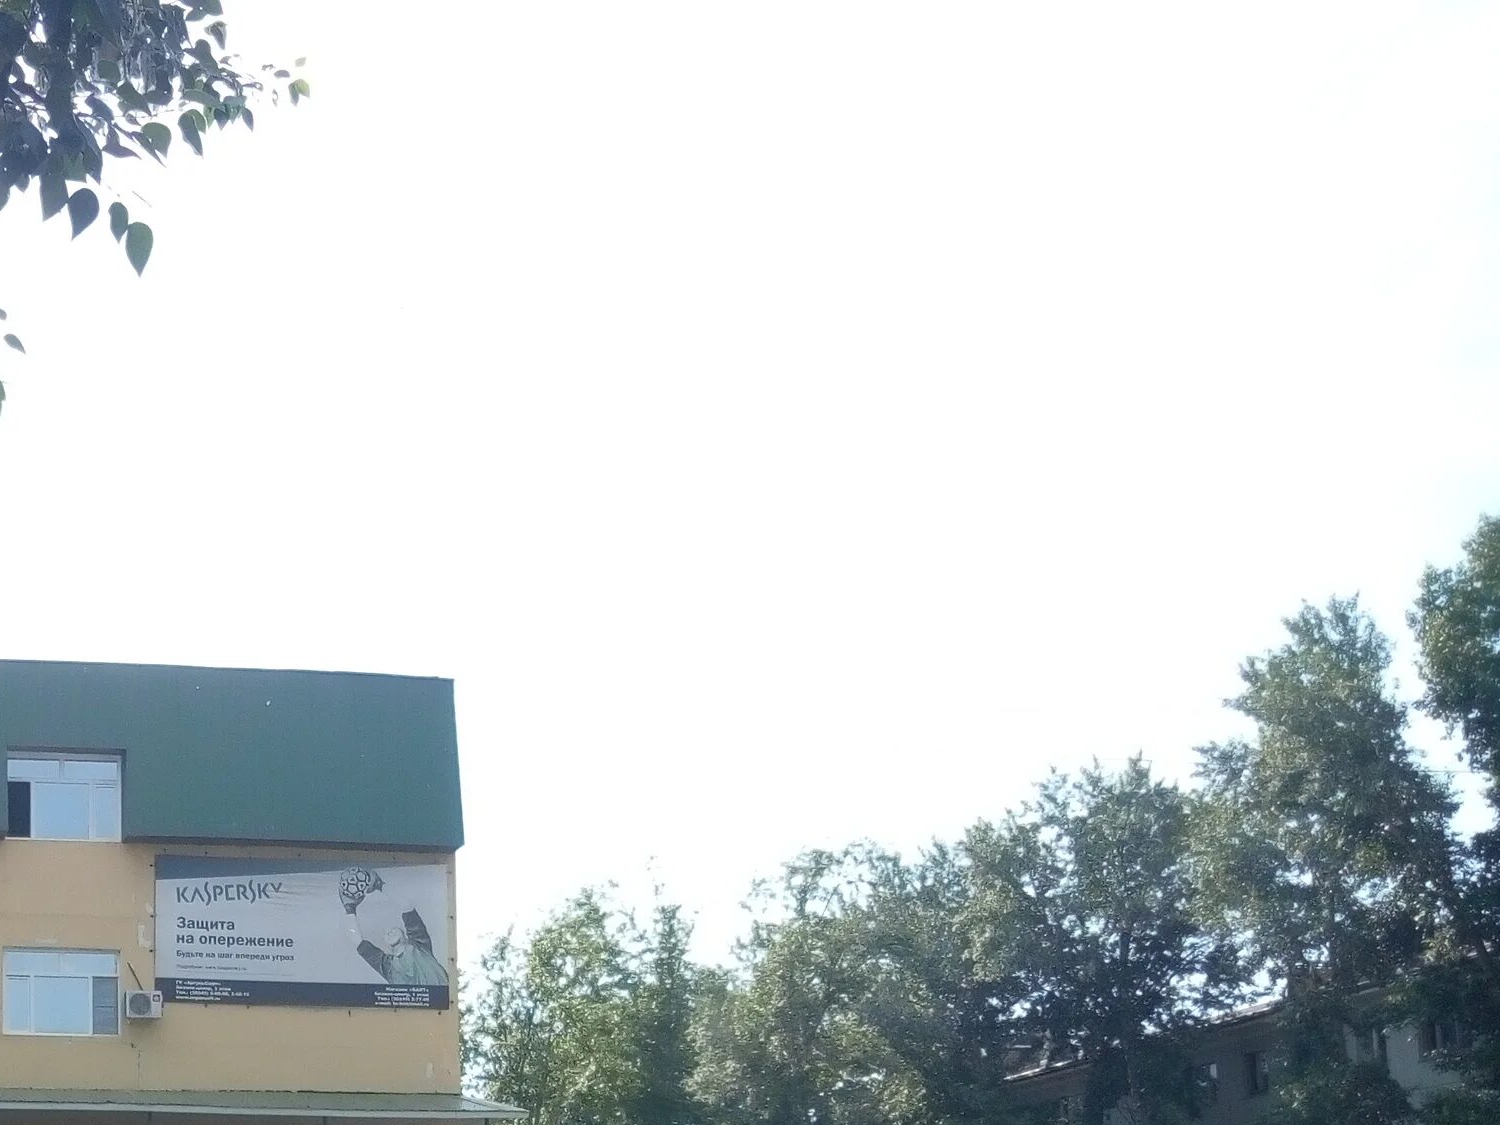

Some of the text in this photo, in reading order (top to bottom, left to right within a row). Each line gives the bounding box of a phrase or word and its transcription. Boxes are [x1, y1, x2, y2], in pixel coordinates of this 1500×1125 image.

[176, 880, 283, 906] KASPERSKY
[177, 916, 235, 931] Защита
[176, 934, 294, 948] на опережение
[176, 950, 204, 960] Будьте
[217, 951, 232, 959] шаг
[235, 952, 270, 960] впереди
[272, 953, 295, 962] угроз
